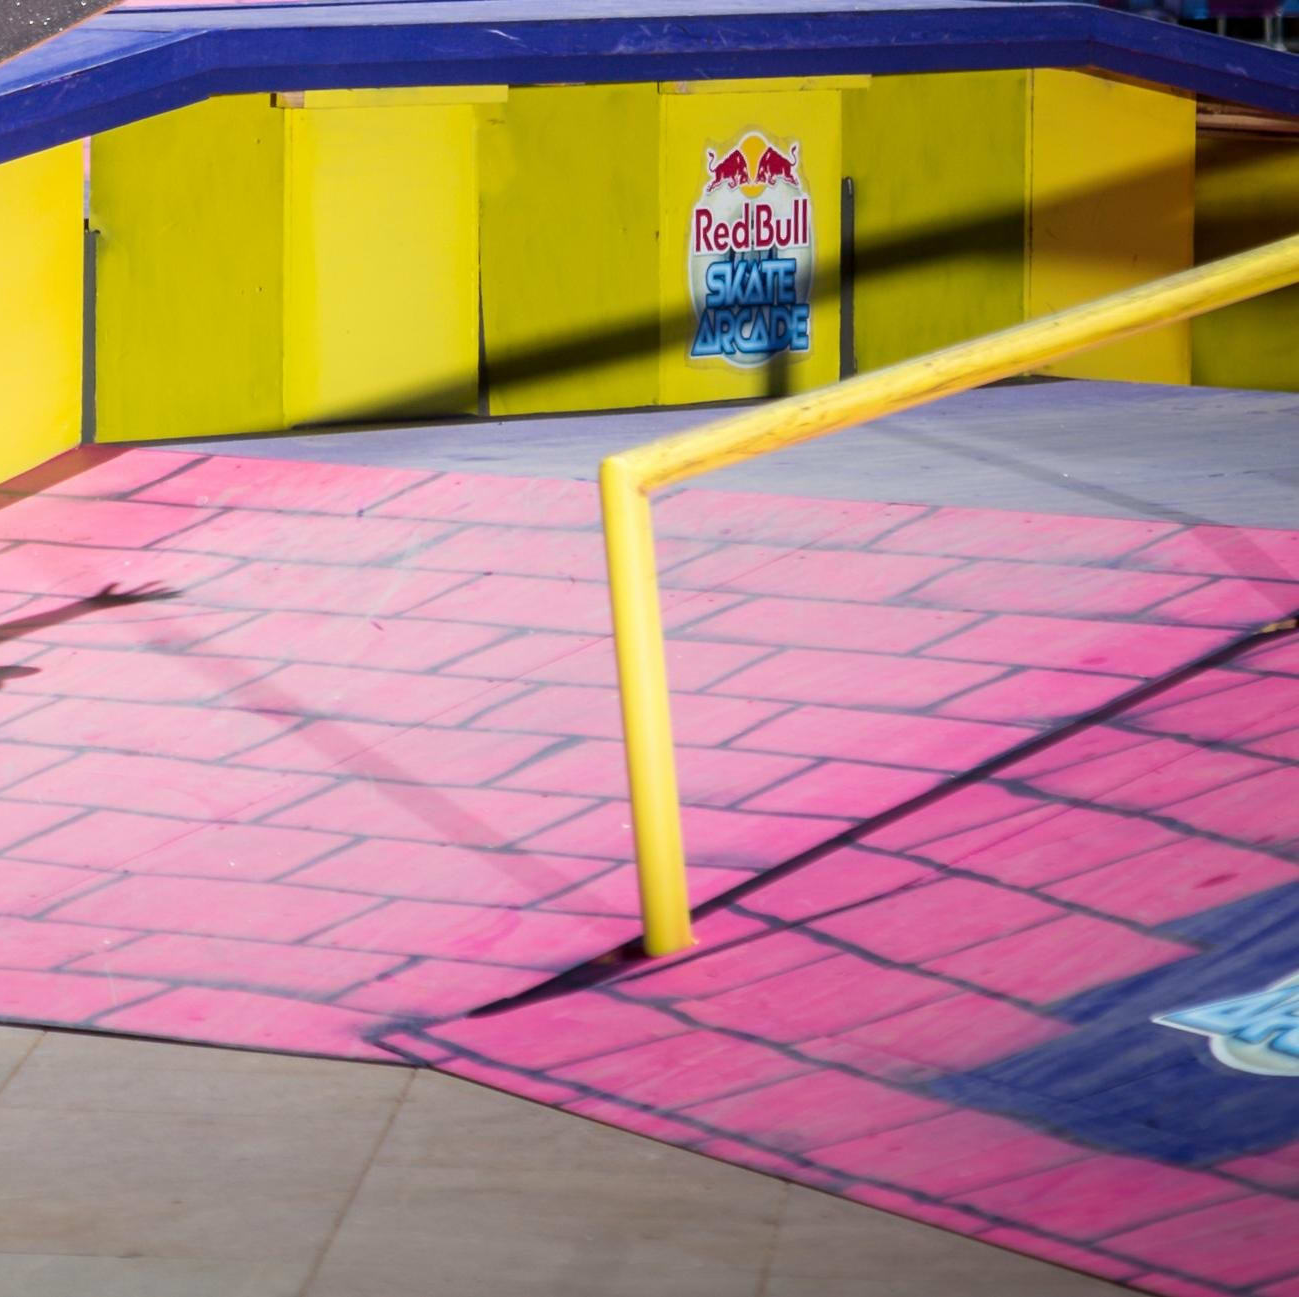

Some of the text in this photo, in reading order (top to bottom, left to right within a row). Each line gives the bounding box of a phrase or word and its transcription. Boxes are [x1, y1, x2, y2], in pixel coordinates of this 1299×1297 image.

[694, 198, 808, 253] Red Bull
[706, 257, 797, 307] SKATE
[691, 304, 810, 357] ARCADE
